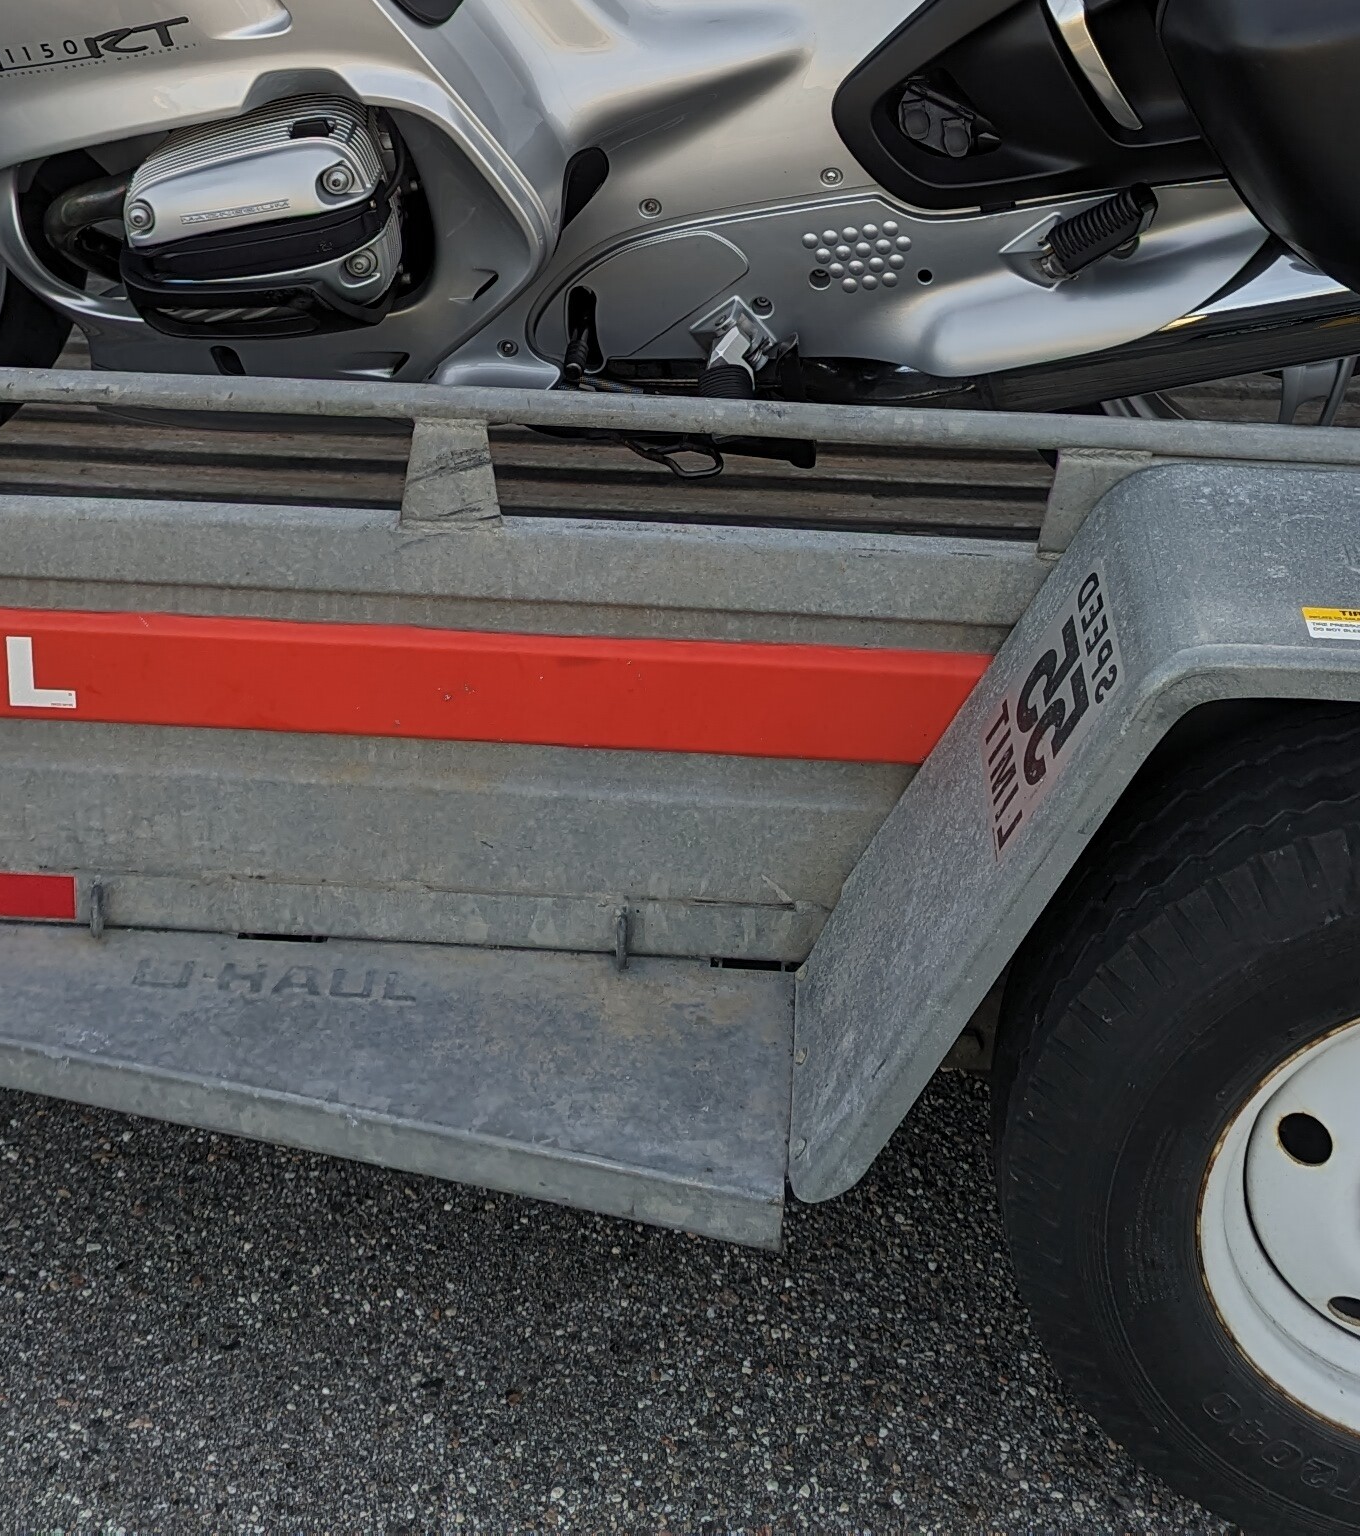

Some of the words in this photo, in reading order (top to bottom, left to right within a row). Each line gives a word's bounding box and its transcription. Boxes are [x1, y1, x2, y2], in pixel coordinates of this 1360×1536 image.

[1016, 615, 1089, 786] 55
[1078, 572, 1118, 704] SPEED
[986, 699, 1023, 851] LIMIT
